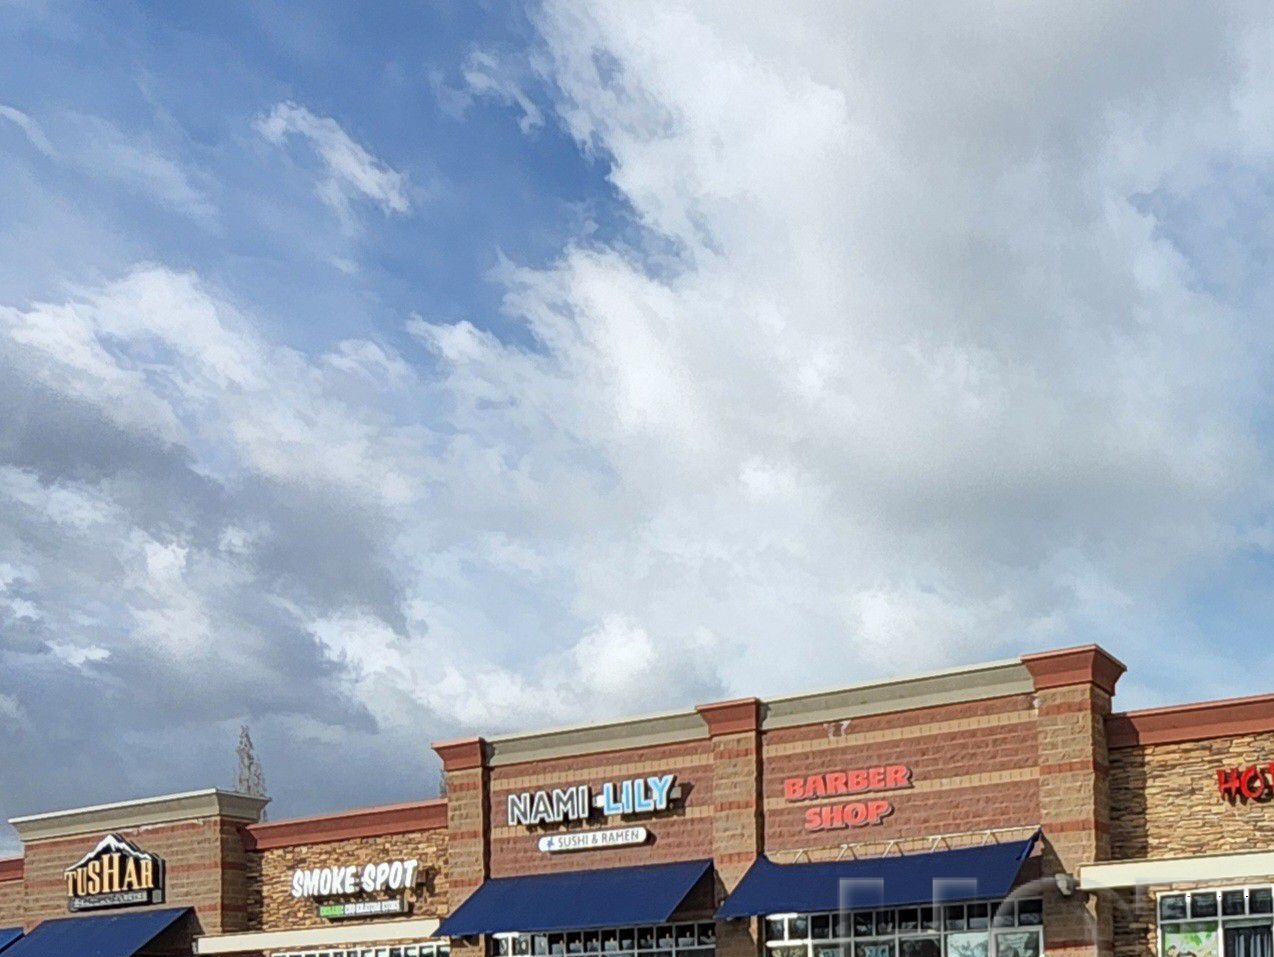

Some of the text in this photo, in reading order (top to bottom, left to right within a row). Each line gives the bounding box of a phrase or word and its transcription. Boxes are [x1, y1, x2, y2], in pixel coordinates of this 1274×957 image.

[507, 774, 675, 827] NAMI LILY
[784, 765, 910, 800] BARBER
[805, 800, 892, 831] SHOP
[557, 829, 640, 848] SUSHI & RAMEN
[63, 851, 154, 897] TUSHAR
[291, 859, 418, 898] SMOKE SPOT
